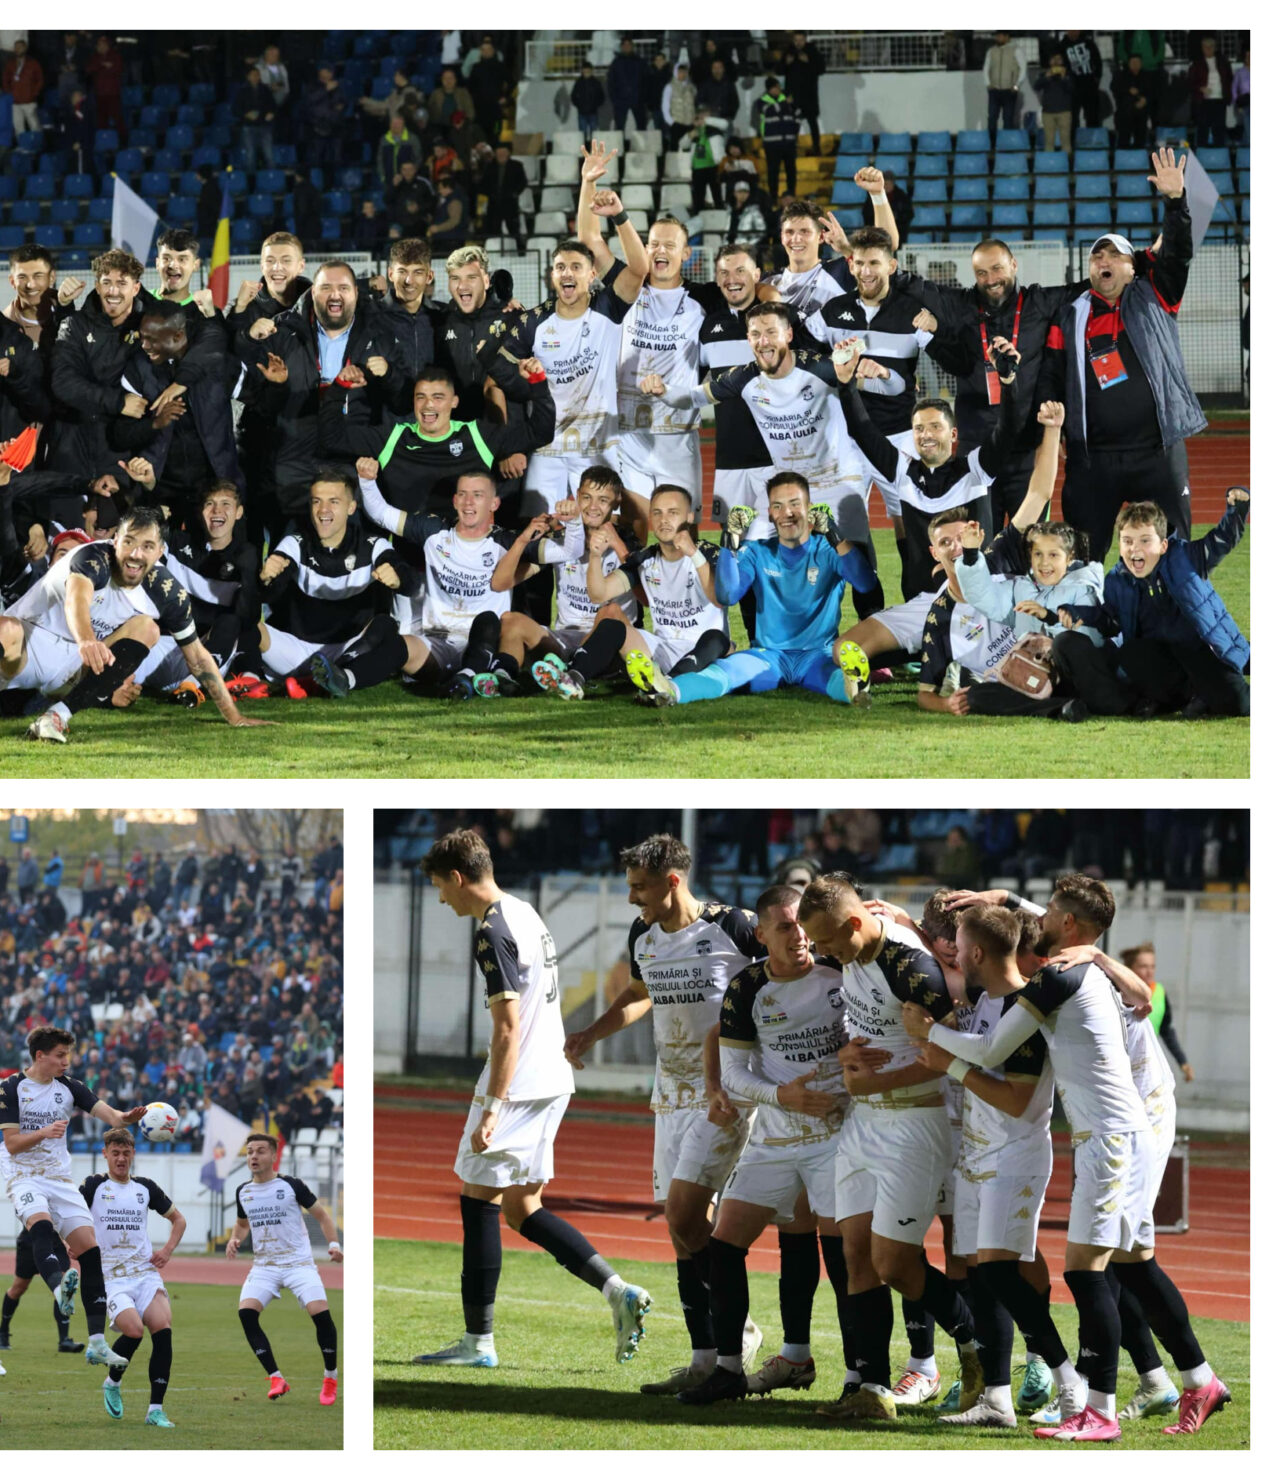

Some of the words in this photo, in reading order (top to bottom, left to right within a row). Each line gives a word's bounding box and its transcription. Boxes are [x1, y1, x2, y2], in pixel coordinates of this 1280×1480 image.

[631, 339, 652, 350] ALBA
[654, 343, 677, 351] IULIA
[769, 432, 792, 441] ALBA
[793, 425, 818, 439] IULIA
[648, 967, 689, 980] PRIMĂRIA
[692, 968, 701, 979] ȘI
[684, 979, 717, 990] LOCAL
[653, 995, 676, 1005] ALBA
[677, 992, 706, 1004] IULIA
[871, 1006, 880, 1017] ȘI
[778, 1024, 830, 1042] PRIMĂRIA
[768, 1037, 823, 1052] CONSILIUL
[20, 1192, 34, 1205] 58
